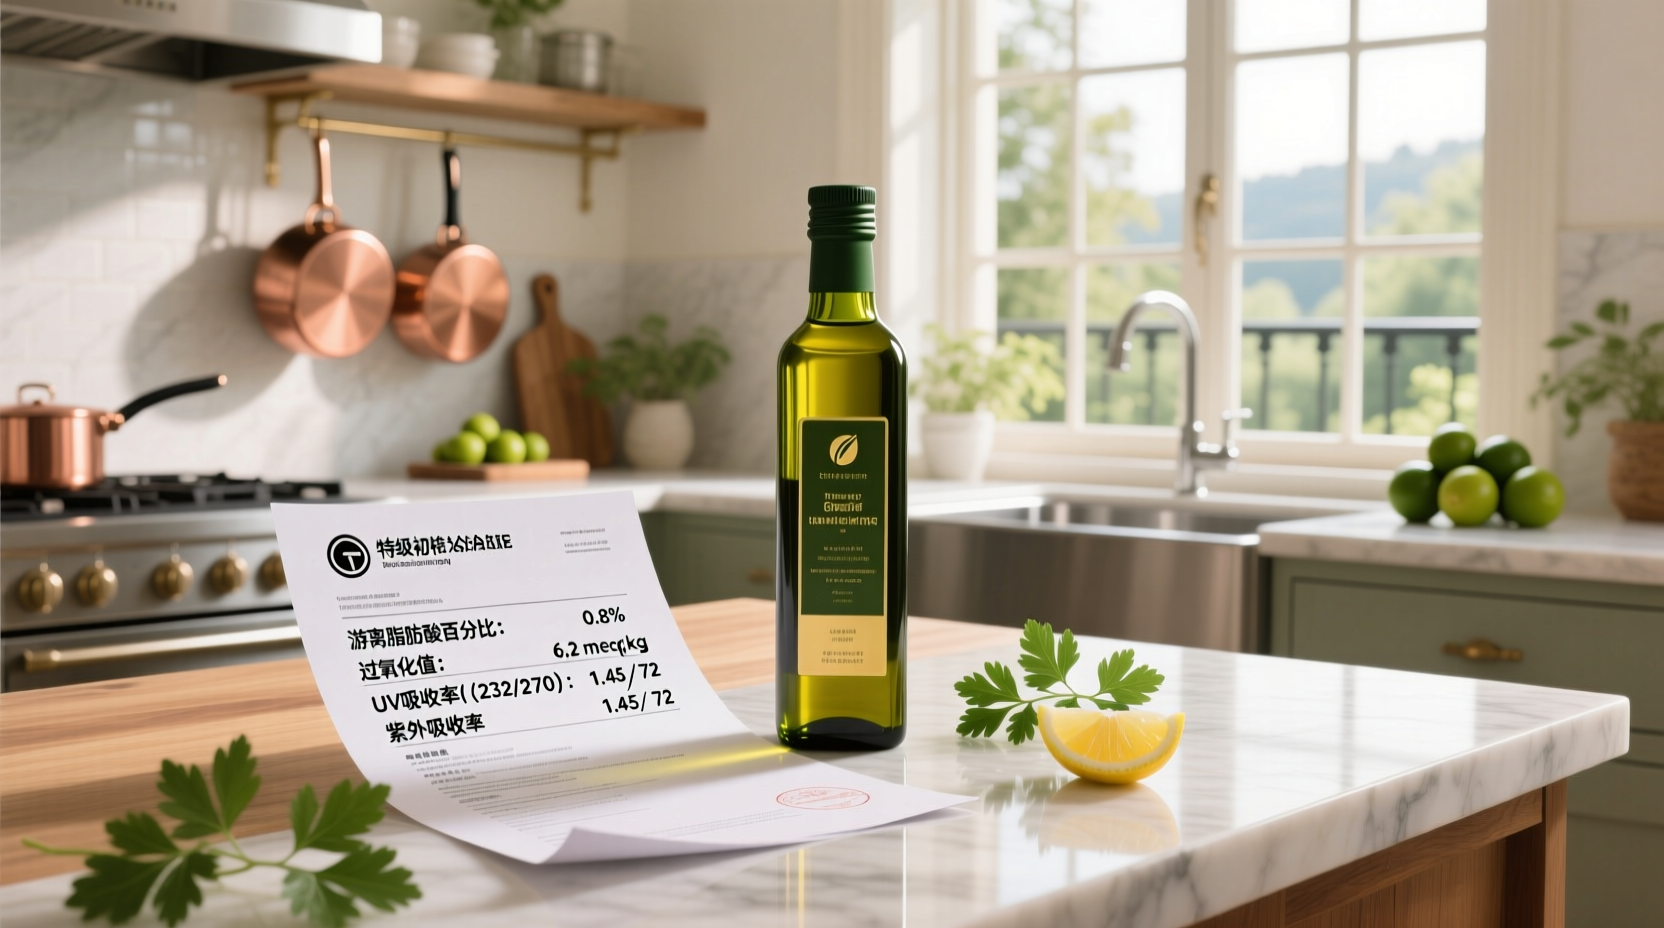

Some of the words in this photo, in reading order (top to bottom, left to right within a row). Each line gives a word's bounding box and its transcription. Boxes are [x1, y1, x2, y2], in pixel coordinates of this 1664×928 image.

[582, 606, 626, 626] 0.8%
[553, 641, 580, 659] 6.2
[386, 713, 486, 743] 紫外吸收率
